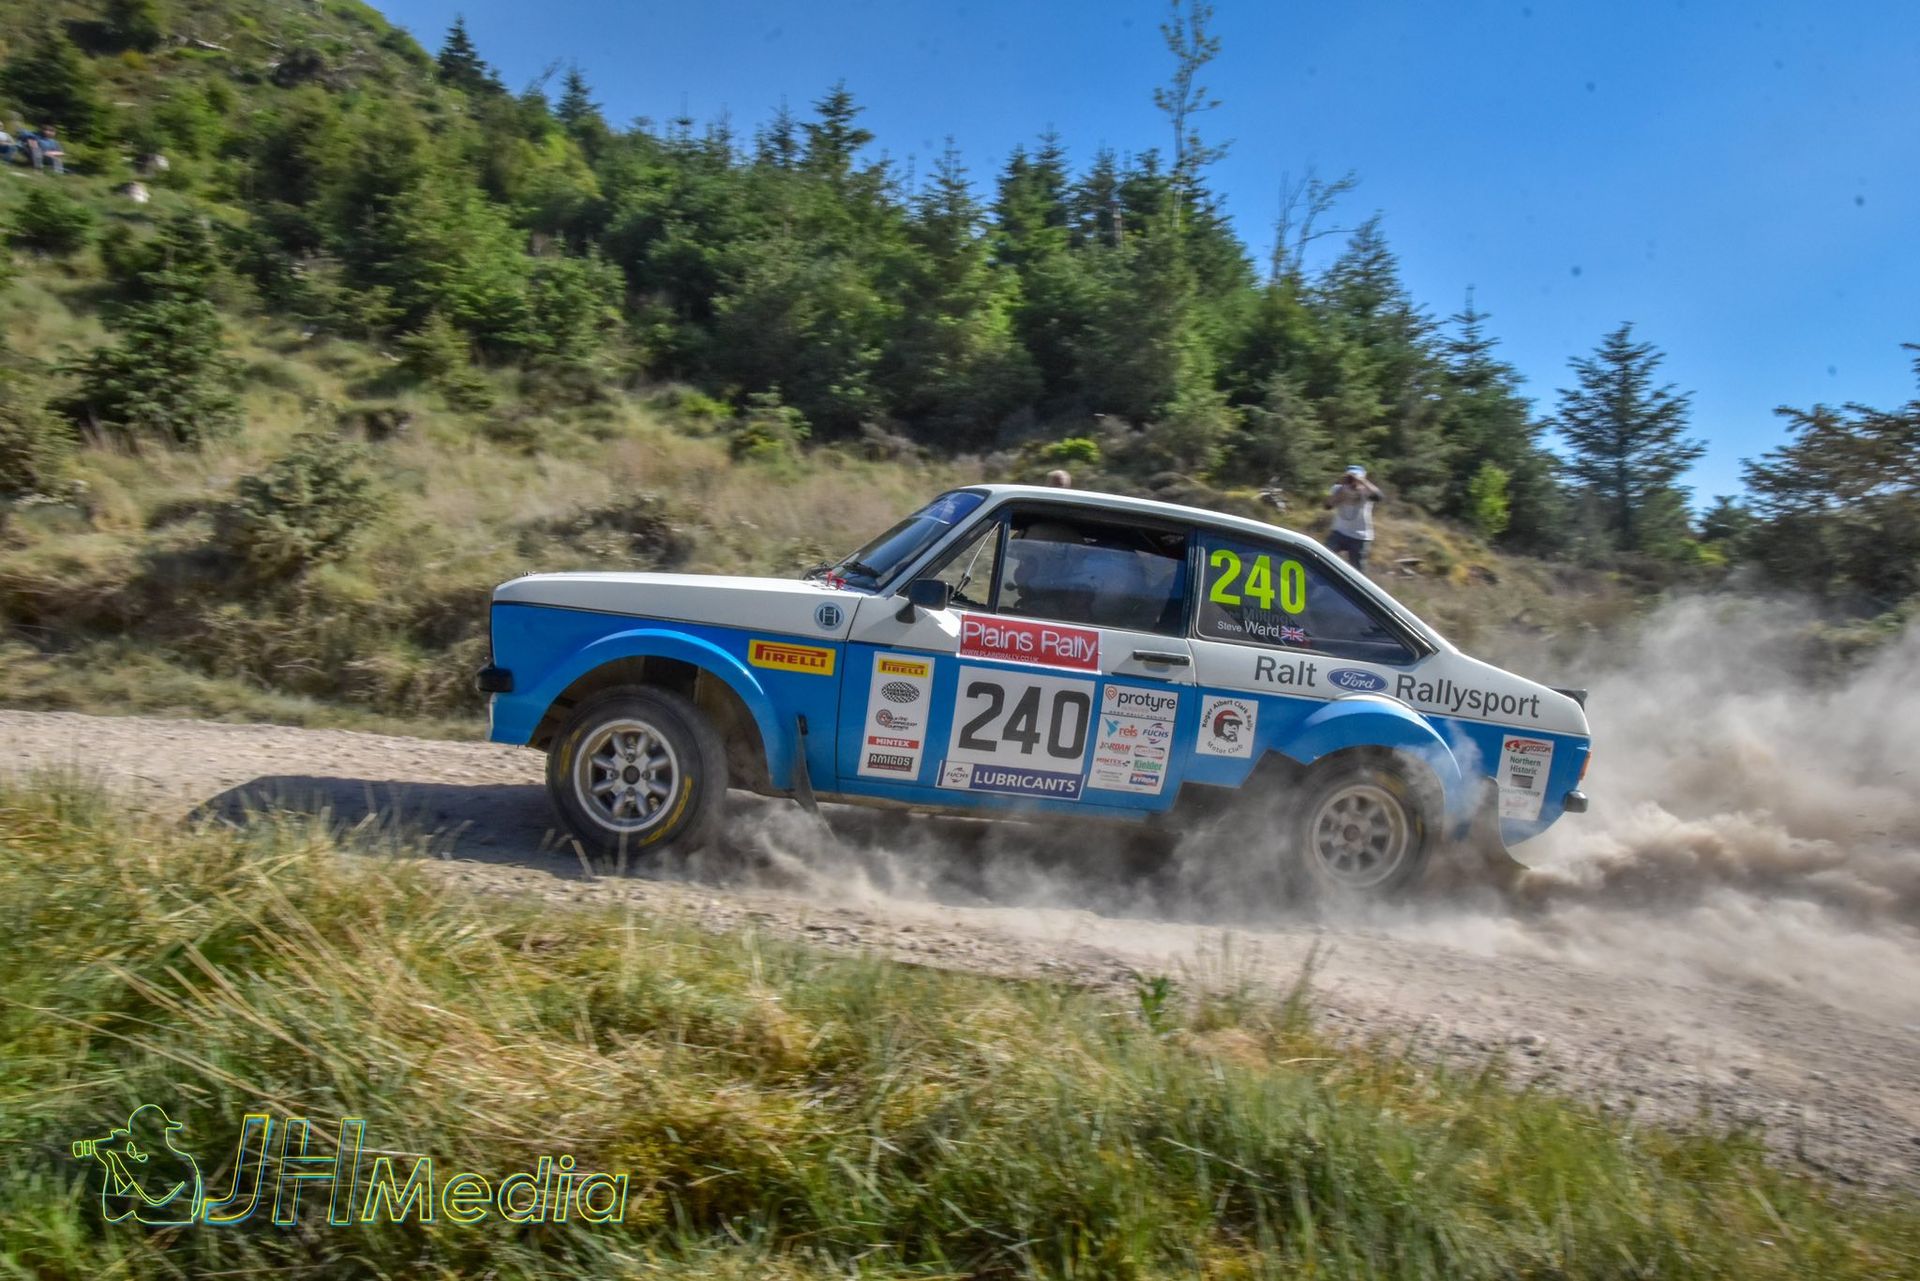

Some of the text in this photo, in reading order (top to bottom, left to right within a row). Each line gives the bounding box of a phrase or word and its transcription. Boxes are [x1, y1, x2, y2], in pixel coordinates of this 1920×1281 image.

[1209, 549, 1306, 615] 240
[1217, 620, 1280, 637] Steve Ward
[962, 620, 1097, 662] Plains Rally
[755, 643, 828, 668] PIRELLI
[881, 661, 926, 676] PIRELLI
[1254, 655, 1540, 719] Ralt Ford Rallysport
[1117, 692, 1176, 712] protyre
[958, 681, 1091, 760] 240
[1119, 724, 1138, 737] reis
[1142, 728, 1169, 738] FUCHS
[875, 737, 910, 748] MINTEX
[870, 754, 911, 766] AMIGOS
[1509, 755, 1541, 766] Northern
[1510, 764, 1537, 775] Historic
[974, 771, 1077, 793] LUBRICANTS
